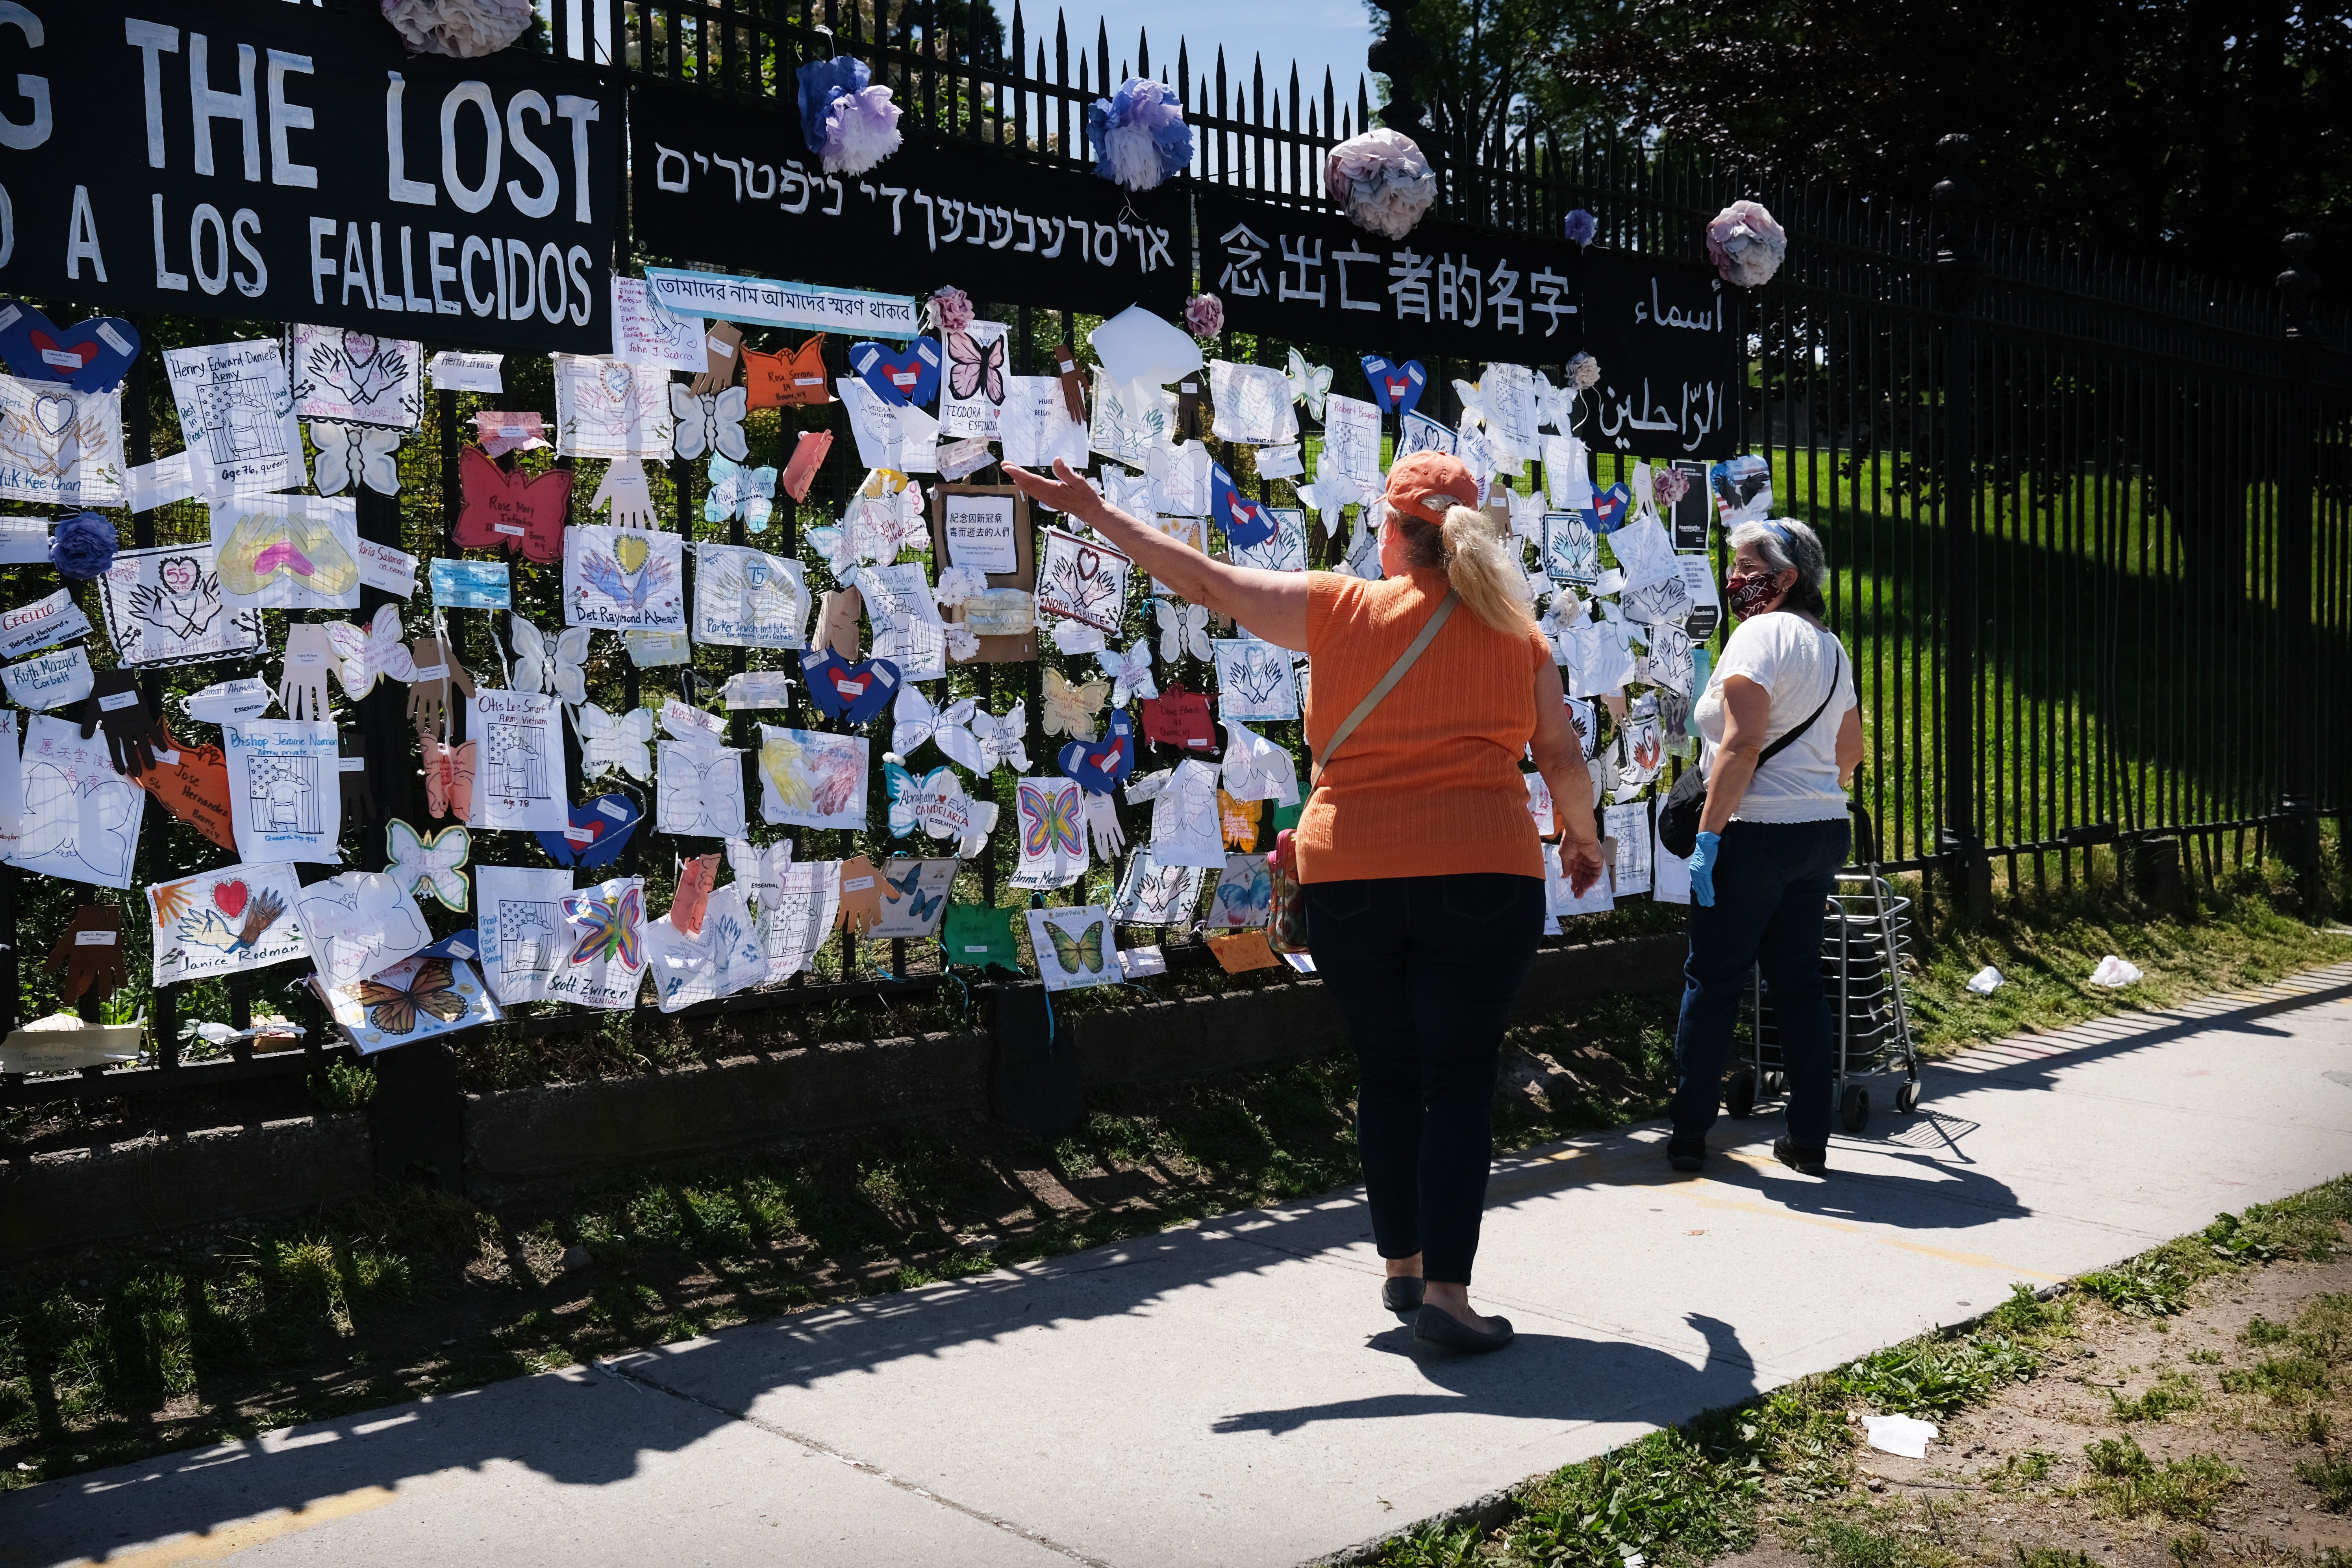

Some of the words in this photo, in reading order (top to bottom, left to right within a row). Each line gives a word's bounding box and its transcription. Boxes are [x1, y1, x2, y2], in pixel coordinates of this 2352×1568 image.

[124, 17, 317, 189] THE
[387, 70, 599, 224] LOST
[67, 185, 107, 283] A
[152, 193, 268, 298] LOS
[310, 217, 591, 326] FALLECIDOS
[1219, 222, 1578, 337] 念出亡者的名字
[656, 278, 726, 300] তোমাদের
[729, 286, 758, 304] নাম
[761, 290, 825, 313] আমাদের
[828, 298, 864, 316] স্মরণ
[870, 303, 909, 320] থাকবে
[1635, 277, 1722, 332] أسماء
[629, 343, 647, 354] John
[172, 359, 204, 378] Henry
[207, 357, 243, 371] Edward
[247, 350, 277, 365] Daniels
[1494, 362, 1510, 377] Raul
[768, 371, 787, 382] Rosa
[789, 369, 814, 381] Serrano
[181, 402, 195, 418] Rest
[945, 405, 981, 418] TEODORA
[1334, 401, 1357, 414] Robert
[969, 420, 998, 431] ESPINOSA
[186, 426, 206, 446] Peace
[1472, 436, 1496, 470] Mahoney
[222, 468, 241, 481] age
[25, 474, 46, 490] Kee
[51, 476, 81, 491] Chan
[749, 476, 772, 492] Asante
[489, 495, 511, 511] Rose
[516, 502, 534, 518] Mary
[731, 494, 764, 506] ESSENTIAL
[500, 513, 533, 527] Infantino
[949, 513, 1002, 524] 紀念因新冠病
[880, 520, 899, 535] John
[905, 523, 926, 538] ESSENTIAL
[949, 527, 1010, 538] 毒而逝去的人們
[885, 527, 906, 545] Toledo
[166, 567, 190, 584] 55
[748, 566, 765, 584] 75
[836, 562, 856, 579] ESSENTIAL
[367, 577, 385, 586] Essential
[865, 574, 892, 585] Arthur
[893, 574, 919, 585] Adams
[1045, 597, 1069, 612] NORA
[3, 604, 54, 631] CECILIO
[576, 607, 600, 622] Det.
[601, 608, 641, 627] Raymond
[644, 609, 678, 625] Abear
[1074, 605, 1105, 625] POBLETE
[58, 626, 91, 641] ESSENTIAL
[735, 621, 757, 633] Jewish
[761, 622, 788, 633] Institute
[9, 632, 35, 650] Beloved
[35, 621, 64, 639] Husband
[27, 634, 50, 647] Father
[378, 634, 395, 647] Silver
[131, 644, 175, 661] Cobble
[180, 641, 200, 653] Hill
[204, 634, 231, 649] Health
[13, 664, 39, 684] Ruth
[41, 652, 79, 673] Mazyck
[32, 673, 70, 690] Corbett
[227, 681, 255, 693] Ahmed
[1127, 676, 1146, 689] ESSENTIAL
[234, 704, 265, 713] ESSENTIAL
[478, 696, 503, 712] Otis
[524, 702, 545, 715] Smart
[1160, 706, 1179, 715] Dave
[522, 715, 548, 725] Vietnam
[671, 704, 693, 724] Kevin
[698, 714, 713, 728] Lee
[231, 733, 269, 749] Bishop
[272, 732, 306, 746] Jerome
[309, 735, 338, 746] Norman
[895, 727, 927, 750] Thomas
[991, 726, 1017, 740] ALONZO
[174, 763, 200, 787] Jose
[148, 777, 161, 789] 56
[182, 784, 228, 817] Hernandez
[503, 799, 515, 808] Age
[518, 799, 530, 807] 78
[899, 790, 939, 806] Abraham
[948, 798, 969, 817] EVA
[915, 805, 969, 827] CANDELARIA
[929, 817, 962, 832] ESSENTIAL
[206, 828, 220, 840] NY
[265, 833, 293, 842] Queens
[1012, 870, 1038, 884] Anna
[479, 915, 498, 927] Thank
[480, 937, 494, 946] for
[176, 957, 228, 973] Janice
[238, 944, 299, 961] Rodman
[549, 974, 576, 992] Scott
[580, 977, 628, 1000] Zwiren
[583, 995, 621, 1005] ESSENTIAL
